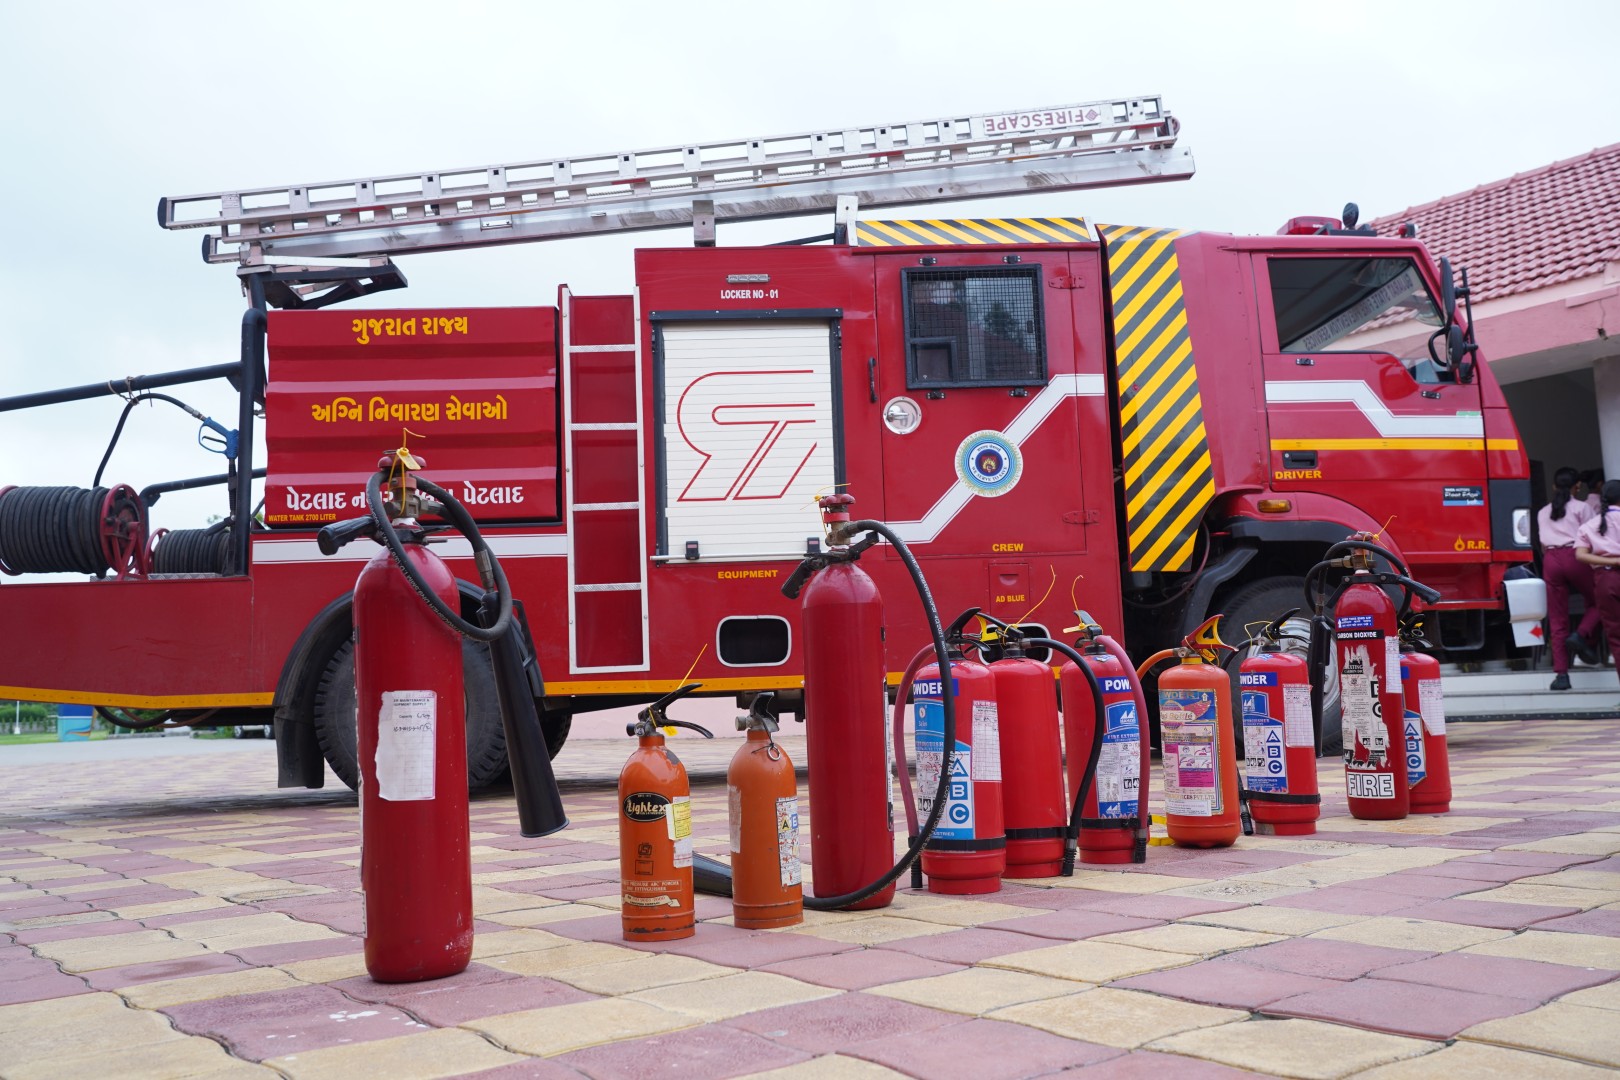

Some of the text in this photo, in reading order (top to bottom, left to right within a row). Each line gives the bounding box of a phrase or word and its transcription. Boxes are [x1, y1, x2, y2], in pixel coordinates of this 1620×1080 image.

[984, 109, 1084, 133] FIRESCAPE
[720, 289, 751, 299] LOCKER
[752, 289, 764, 299] NO
[769, 288, 779, 298] 01
[352, 317, 416, 345] ગુજરાત
[311, 394, 508, 423] અગ્નિ નિવારણ સેવાઓ
[1274, 470, 1322, 480] DRIVER
[286, 486, 347, 510] પેટલાદ
[463, 480, 525, 505] પેટલાદ
[320, 513, 337, 521] LITER
[992, 543, 1024, 552] CREW
[1467, 540, 1490, 550] R.R.
[717, 569, 778, 580] EQUIPMENT
[995, 594, 1025, 603] AD BLUE
[1105, 679, 1132, 691] POW
[1240, 675, 1267, 685] WDER
[1347, 774, 1393, 797] FIRE
[628, 801, 667, 814] Lightex
[782, 821, 789, 829] A
